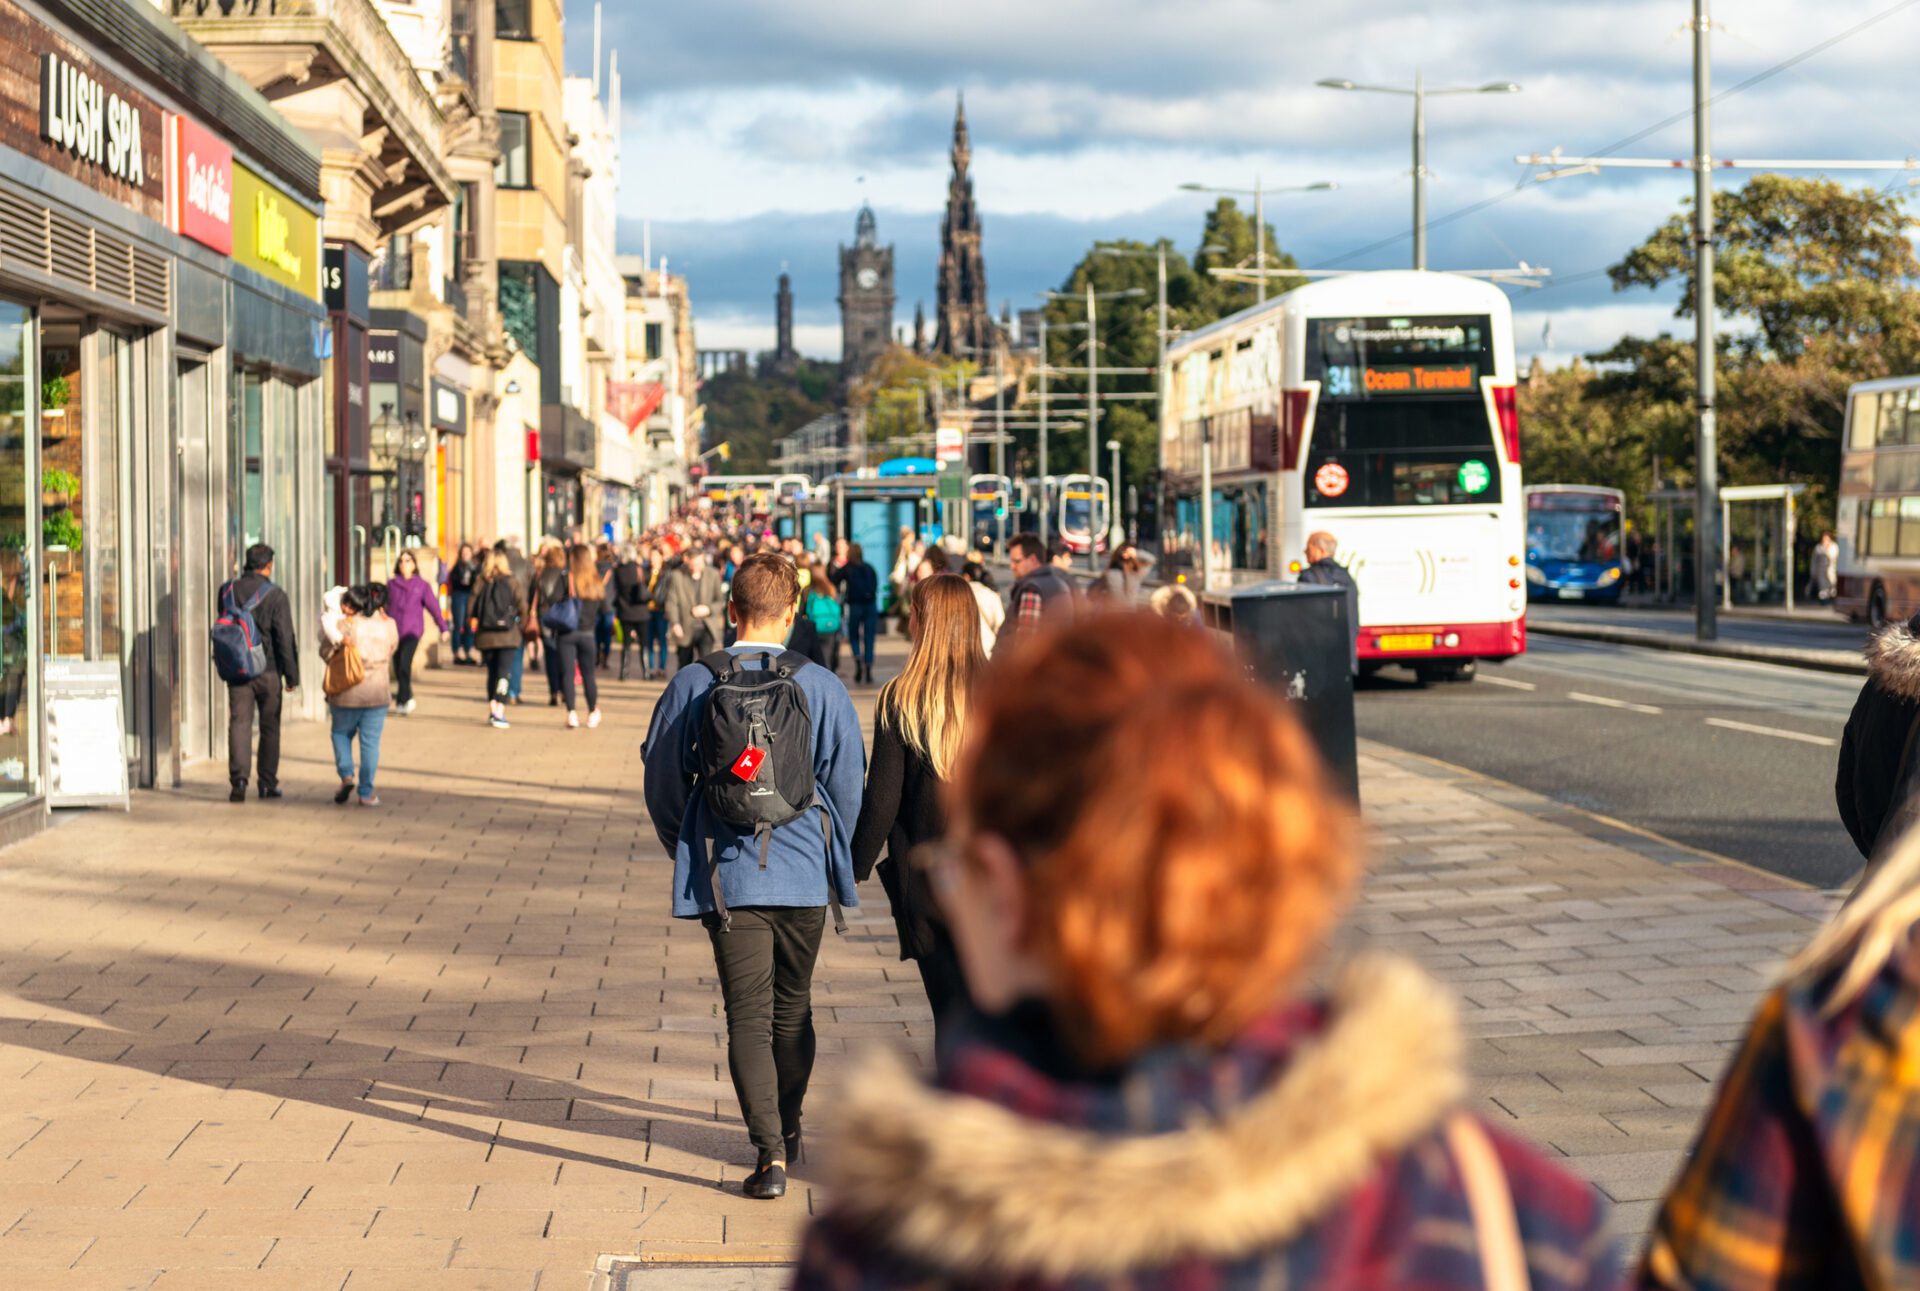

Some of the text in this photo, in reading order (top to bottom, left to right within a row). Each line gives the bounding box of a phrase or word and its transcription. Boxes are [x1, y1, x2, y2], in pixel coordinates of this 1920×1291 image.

[48, 52, 144, 187] LUSH SPA
[1413, 326, 1464, 341] Edinburgh
[1328, 366, 1471, 395] 34 Ocean Terminal
